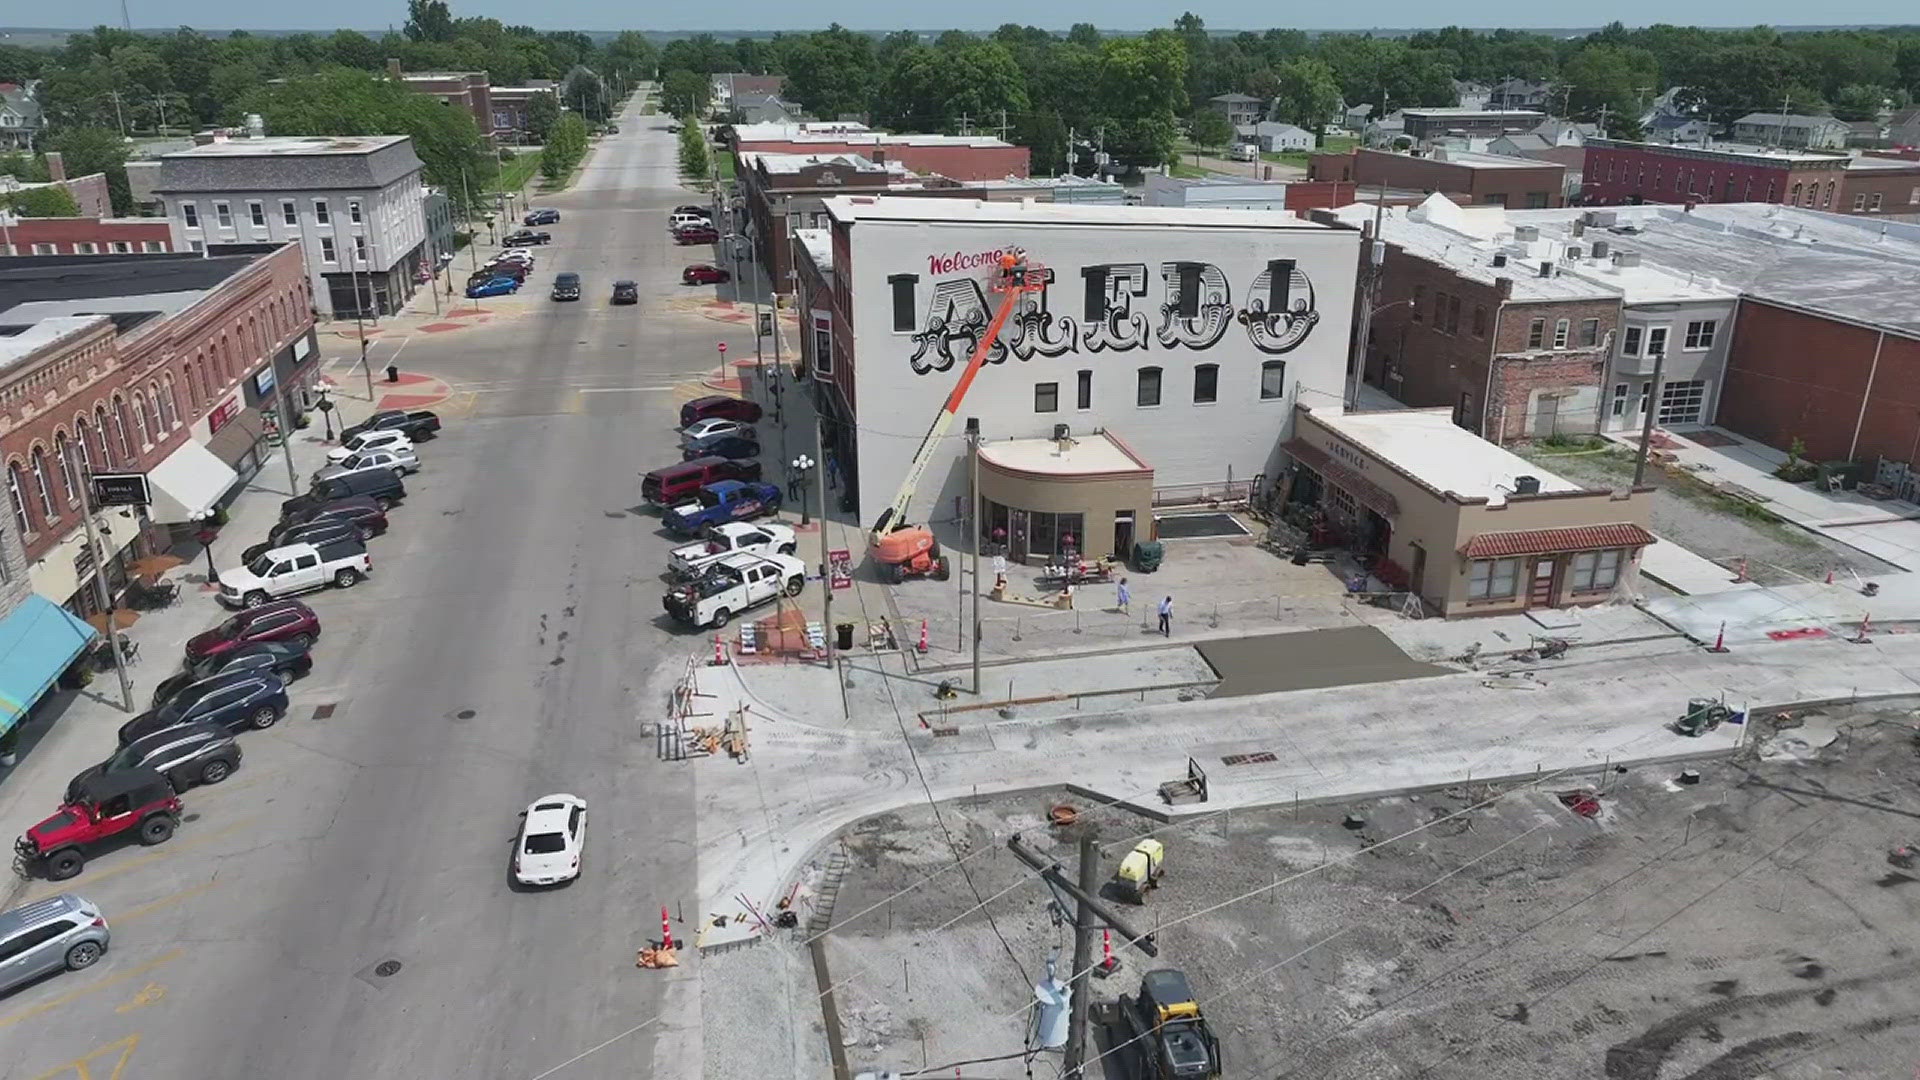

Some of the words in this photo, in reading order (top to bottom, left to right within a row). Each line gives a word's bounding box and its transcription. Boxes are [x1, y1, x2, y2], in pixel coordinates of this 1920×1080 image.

[927, 249, 1004, 275] Welcome
[911, 261, 1320, 375] ALEDO
[1330, 442, 1364, 469] SERVICE
